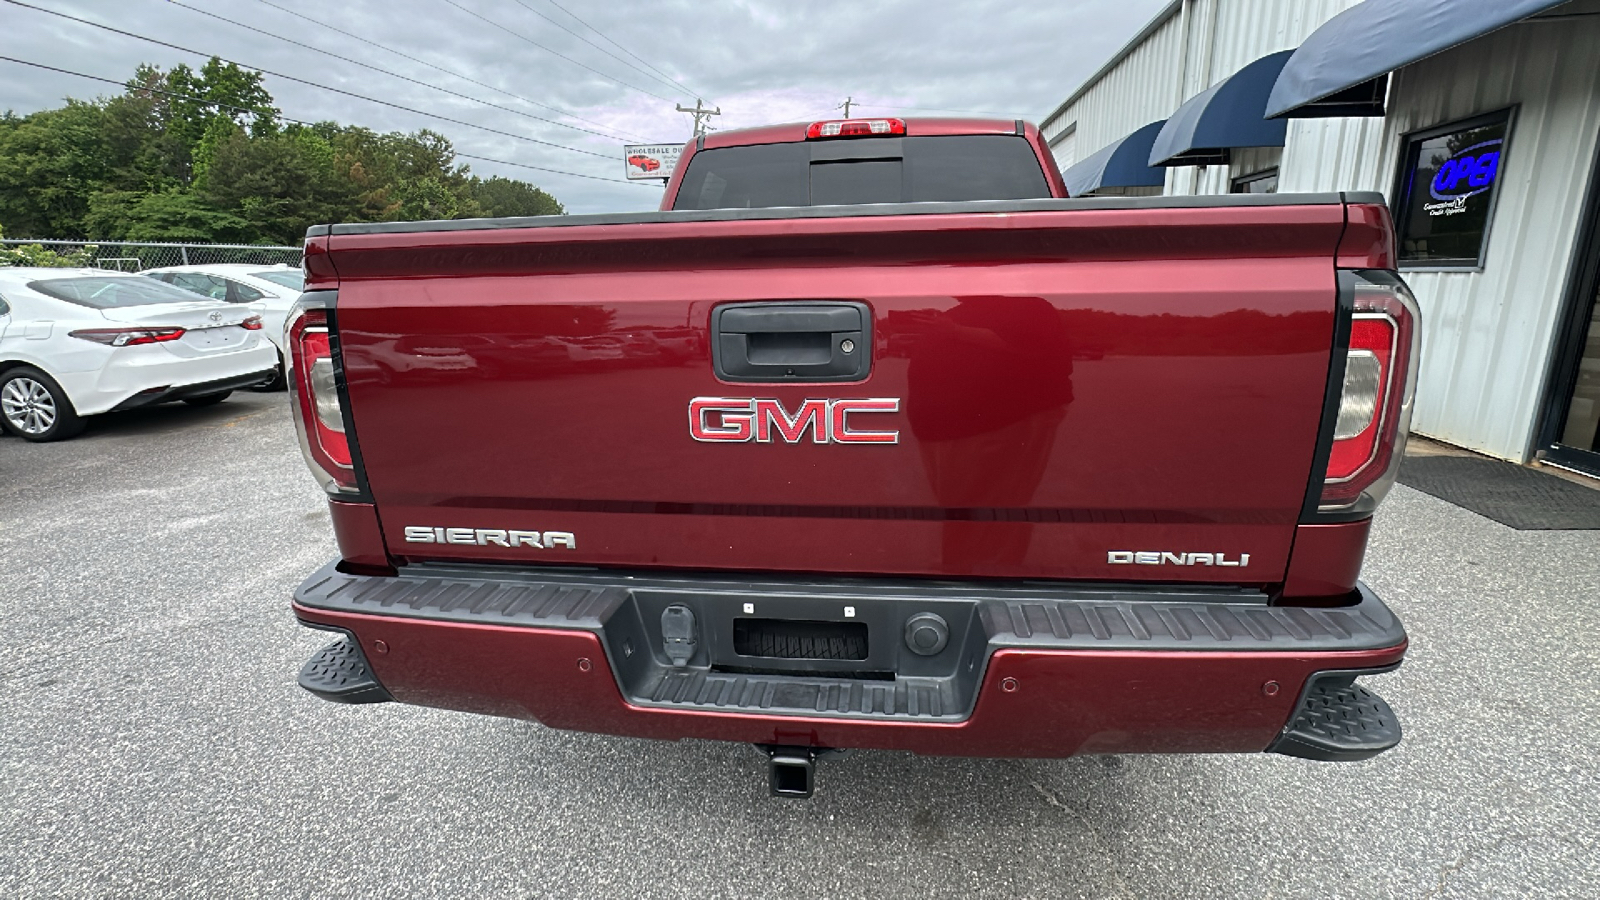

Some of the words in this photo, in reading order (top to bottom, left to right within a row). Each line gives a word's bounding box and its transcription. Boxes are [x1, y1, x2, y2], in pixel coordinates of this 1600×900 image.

[688, 397, 900, 444] GMC
[404, 526, 576, 549] SIERRA
[1107, 551, 1250, 567] DENALI
